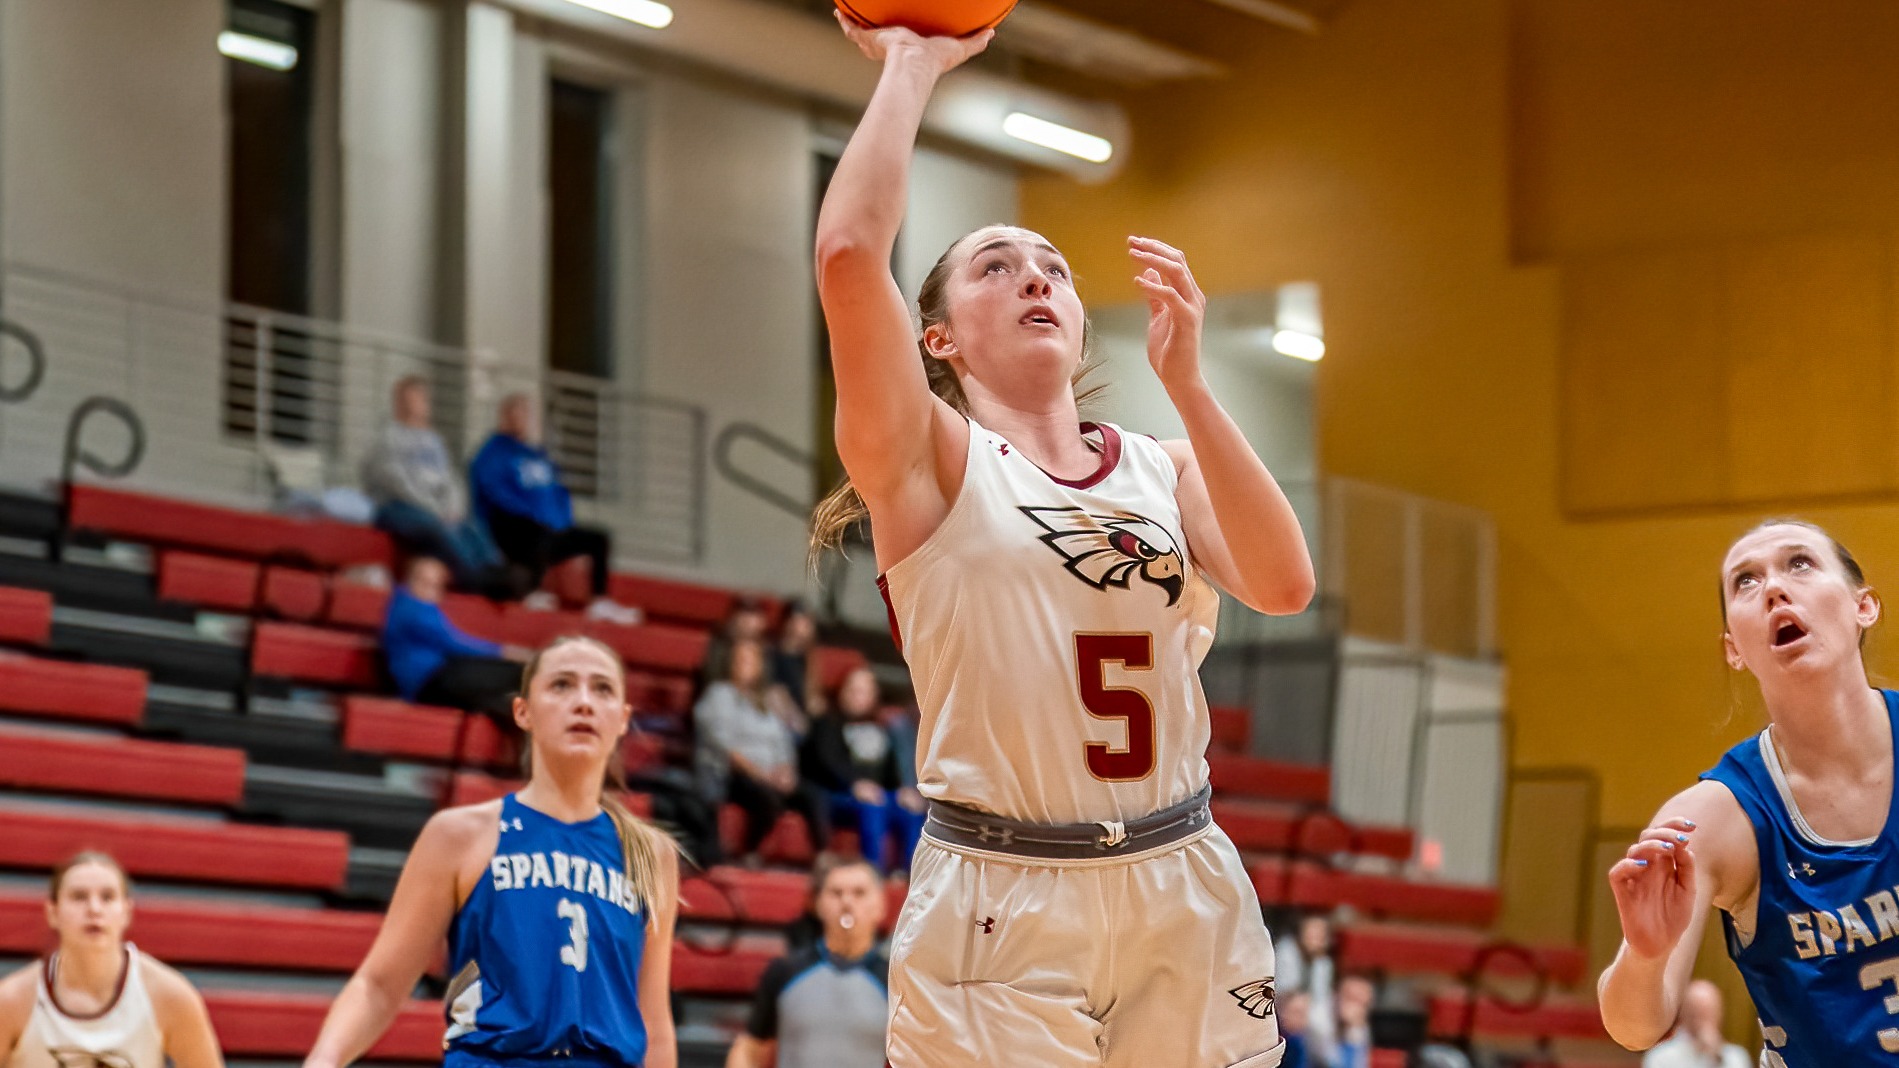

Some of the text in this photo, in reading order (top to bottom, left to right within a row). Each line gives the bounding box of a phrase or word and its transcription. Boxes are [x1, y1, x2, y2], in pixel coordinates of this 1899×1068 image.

[1072, 630, 1157, 783] 5
[491, 851, 640, 915] SPARTANS
[557, 897, 589, 973] 3
[1787, 884, 1899, 959] SPAR
